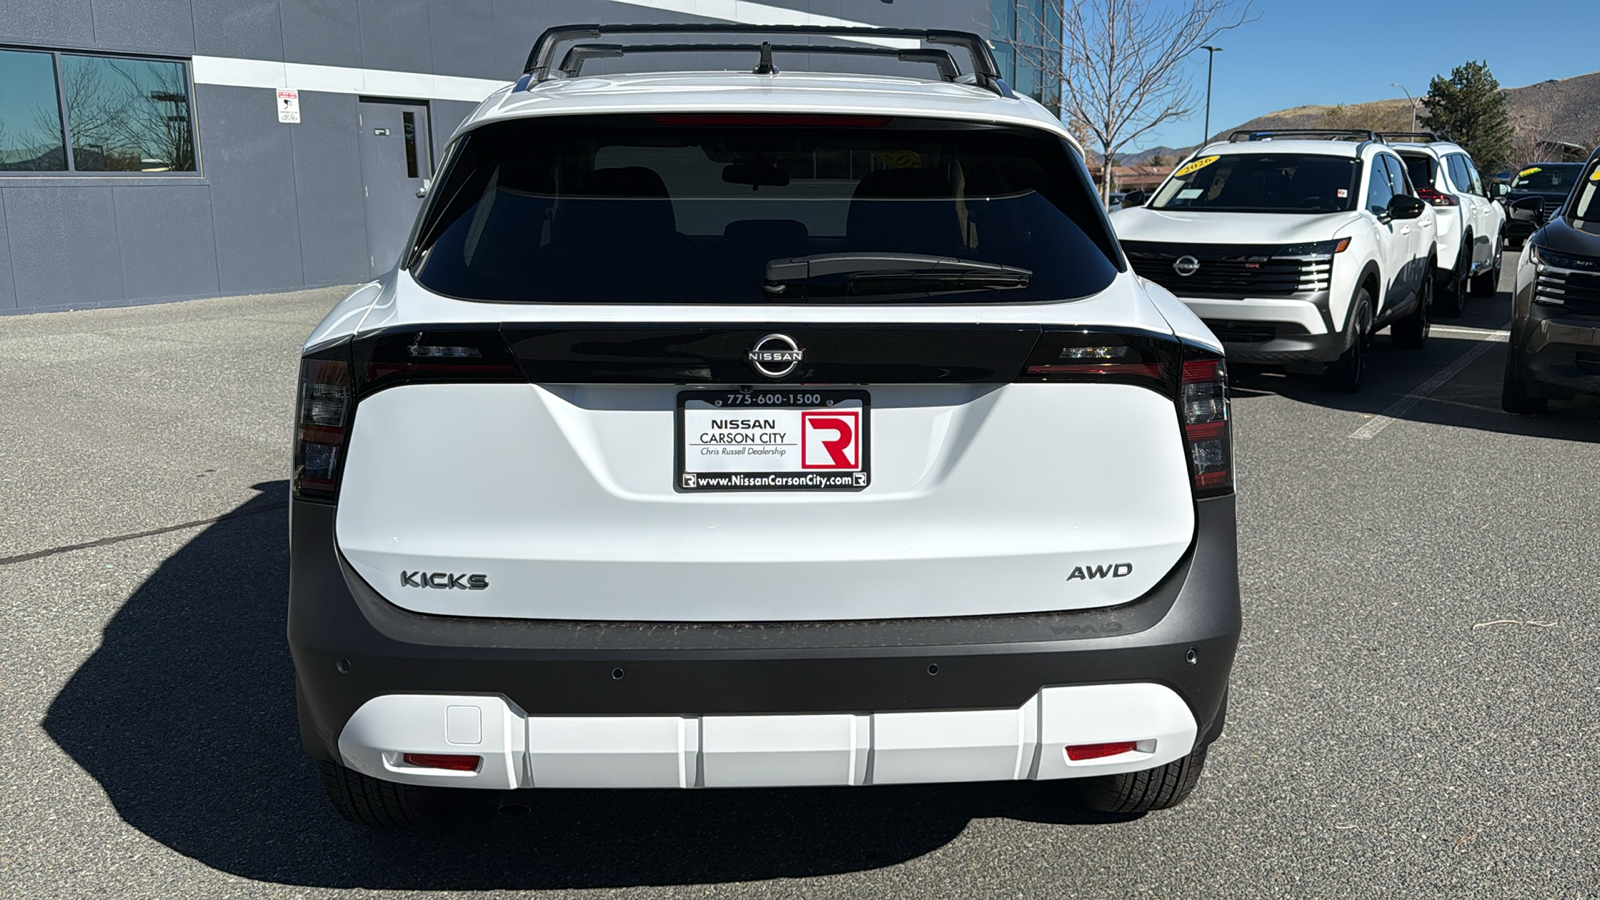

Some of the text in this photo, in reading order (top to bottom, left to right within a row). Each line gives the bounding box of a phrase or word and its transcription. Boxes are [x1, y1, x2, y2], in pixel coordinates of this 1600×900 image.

[1184, 157, 1213, 173] 2026
[748, 352, 803, 361] NISSAN
[727, 393, 821, 405] 775-600-1500
[711, 419, 776, 430] NISSAN
[699, 432, 787, 444] CARSON CITY
[807, 418, 853, 467] R
[700, 446, 787, 457] Chris Russell Dealership
[698, 474, 852, 488] www.NissanCarsonCity.com
[1066, 562, 1133, 581] AWD
[400, 569, 490, 590] KICKS
